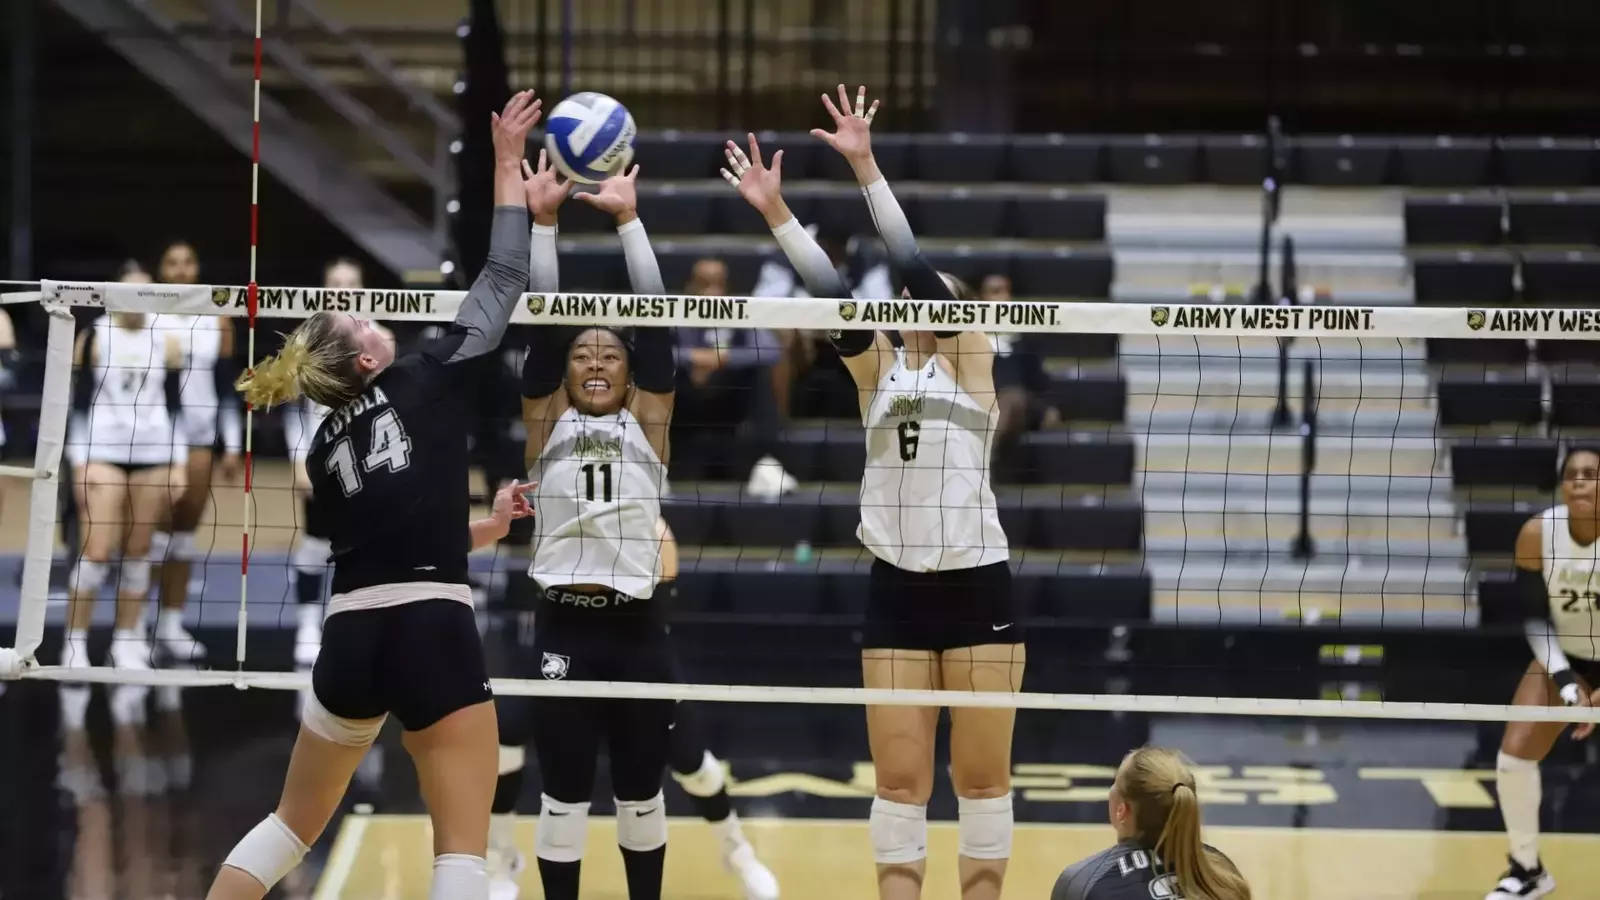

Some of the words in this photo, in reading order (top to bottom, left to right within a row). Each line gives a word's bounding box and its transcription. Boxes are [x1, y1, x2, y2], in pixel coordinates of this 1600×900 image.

[235, 287, 298, 310] ARMY
[302, 289, 365, 313] WEST
[550, 295, 612, 317] ARMY
[616, 297, 679, 319] WEST
[861, 302, 924, 324] ARMY
[928, 303, 990, 325] WEST
[1173, 306, 1237, 329] ARMY
[1241, 307, 1304, 330] WEST
[1490, 310, 1555, 332] ARMY
[325, 407, 412, 498] 14
[897, 421, 921, 462] 6
[581, 463, 612, 503] 11
[560, 592, 608, 608] PRO
